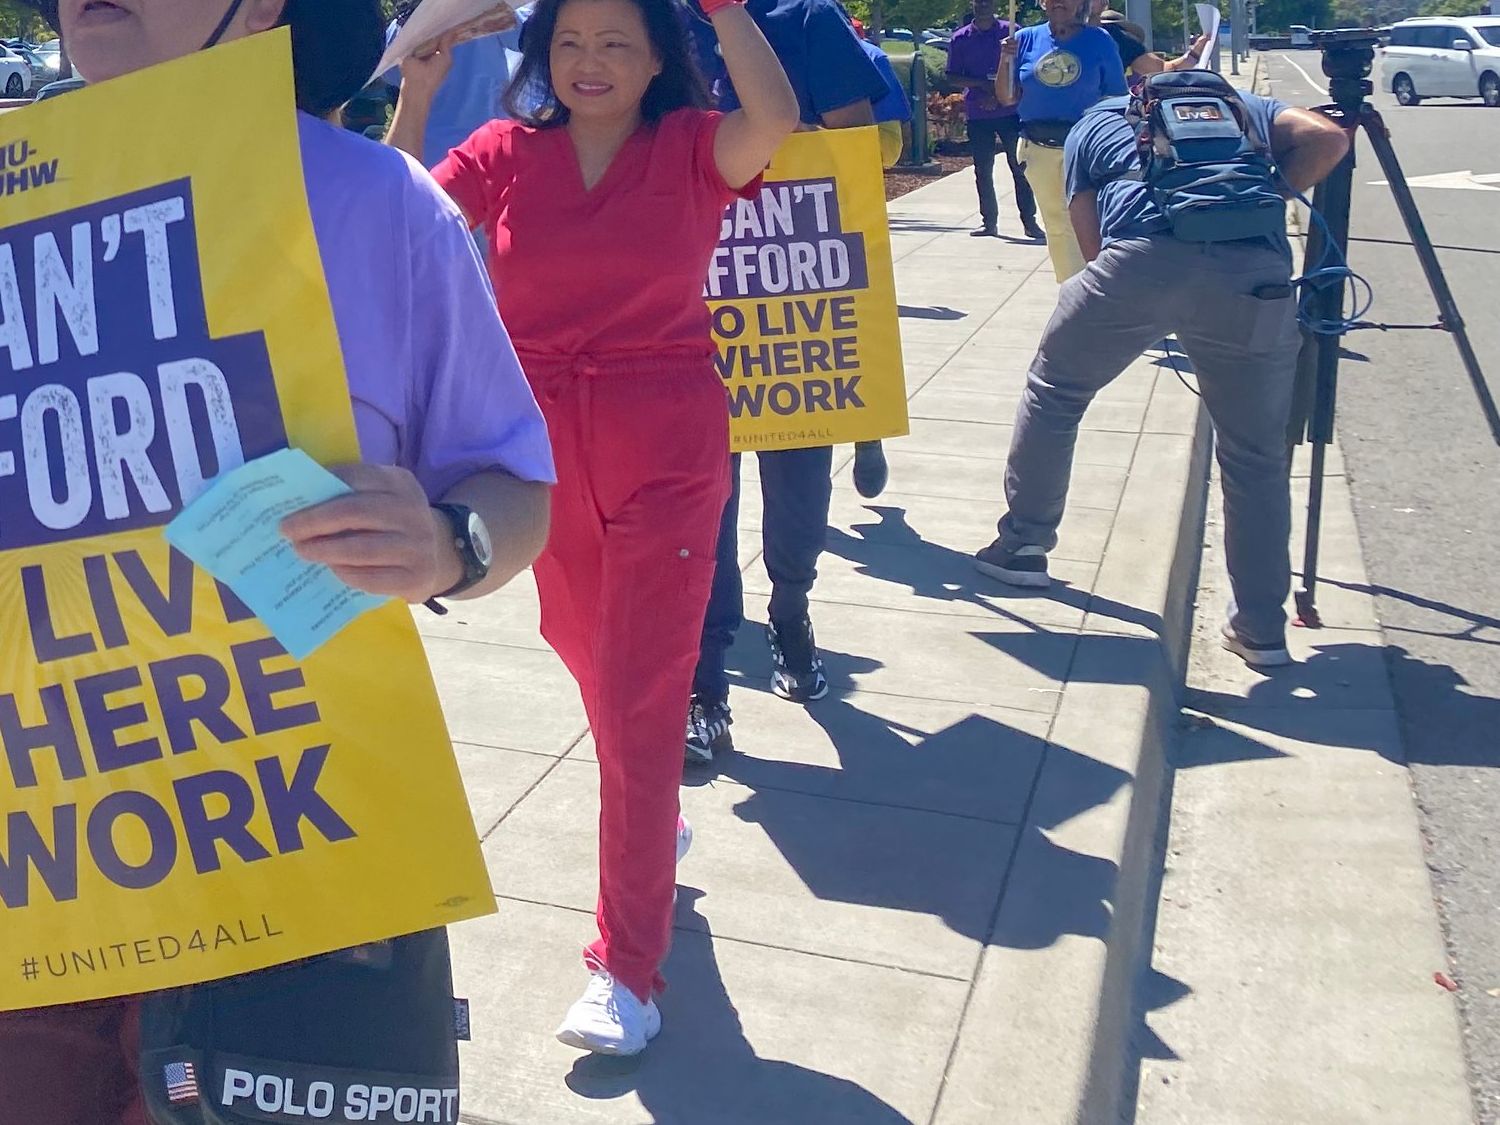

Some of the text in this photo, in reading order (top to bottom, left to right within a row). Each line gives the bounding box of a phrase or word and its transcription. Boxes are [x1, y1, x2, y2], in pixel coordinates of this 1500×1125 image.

[702, 239, 851, 297] FFORD
[712, 296, 858, 339] O LIVE
[726, 375, 866, 418] WORK
[733, 427, 835, 444] #UNITED4ALL
[21, 546, 262, 663] LIV
[21, 913, 284, 981] #UNITED4ALL
[221, 1068, 458, 1122] POLO SPORT
